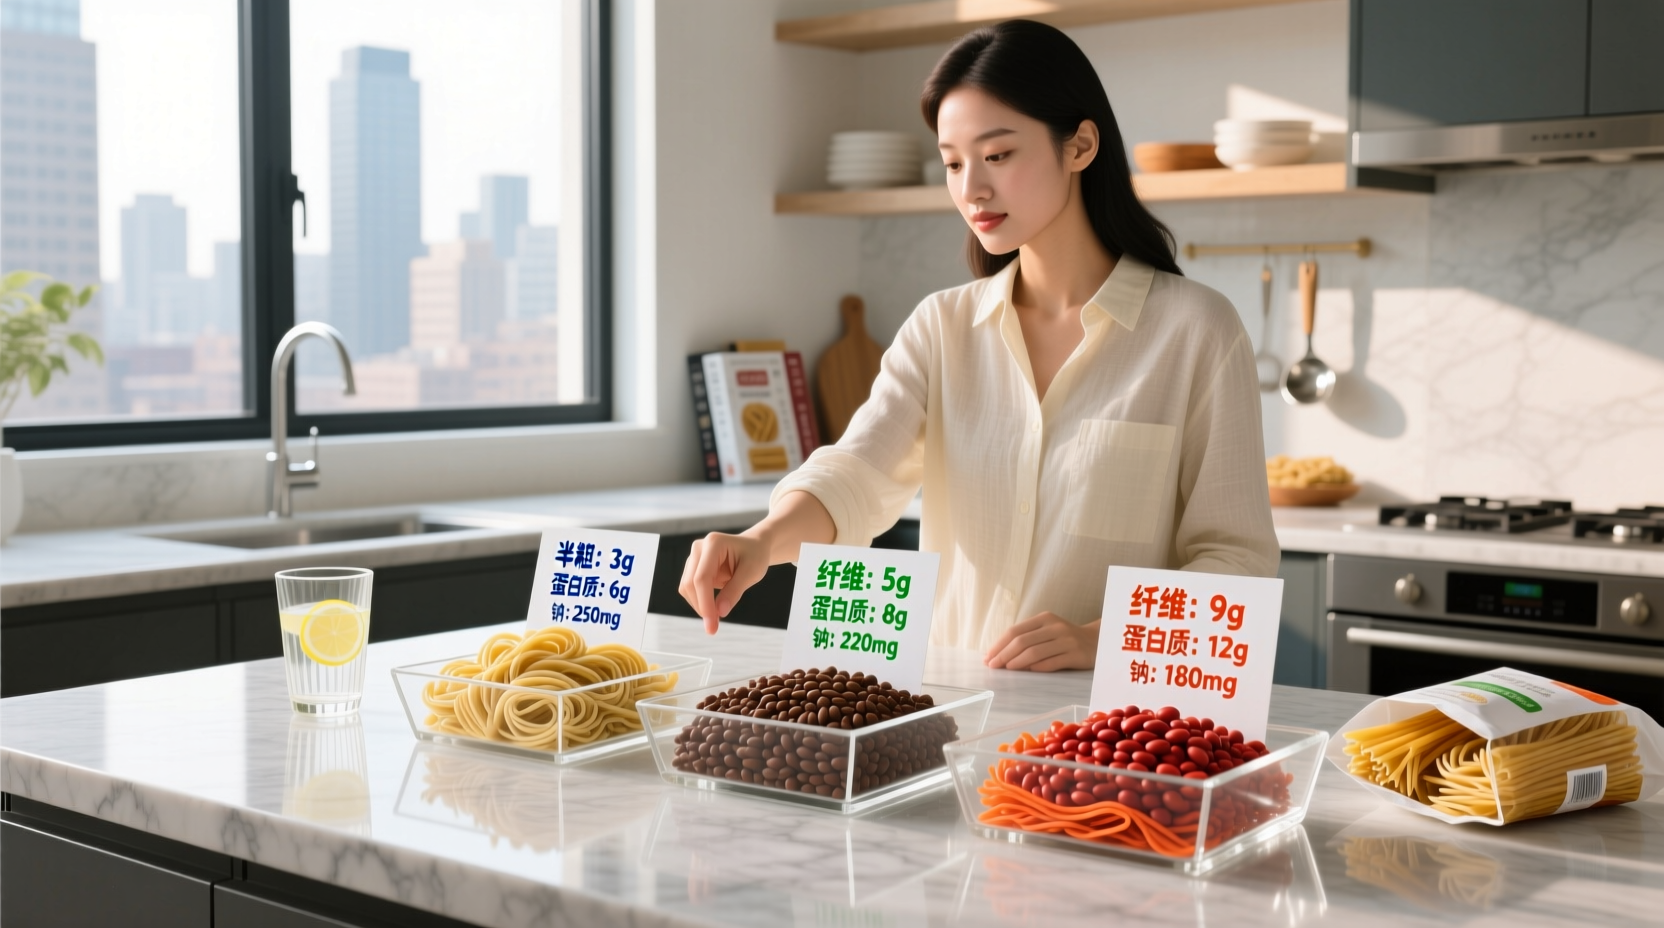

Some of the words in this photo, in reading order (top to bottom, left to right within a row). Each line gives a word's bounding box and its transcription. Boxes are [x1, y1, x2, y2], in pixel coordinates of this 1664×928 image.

[609, 548, 635, 576] 3g
[609, 580, 631, 604] 6g
[881, 567, 912, 599] 5g
[572, 605, 621, 630] 250mg
[882, 603, 908, 631] 8g
[1209, 594, 1246, 631] 9g
[839, 631, 899, 661] 220mg
[1208, 635, 1249, 667] 12g
[1165, 664, 1238, 699] 180mg
